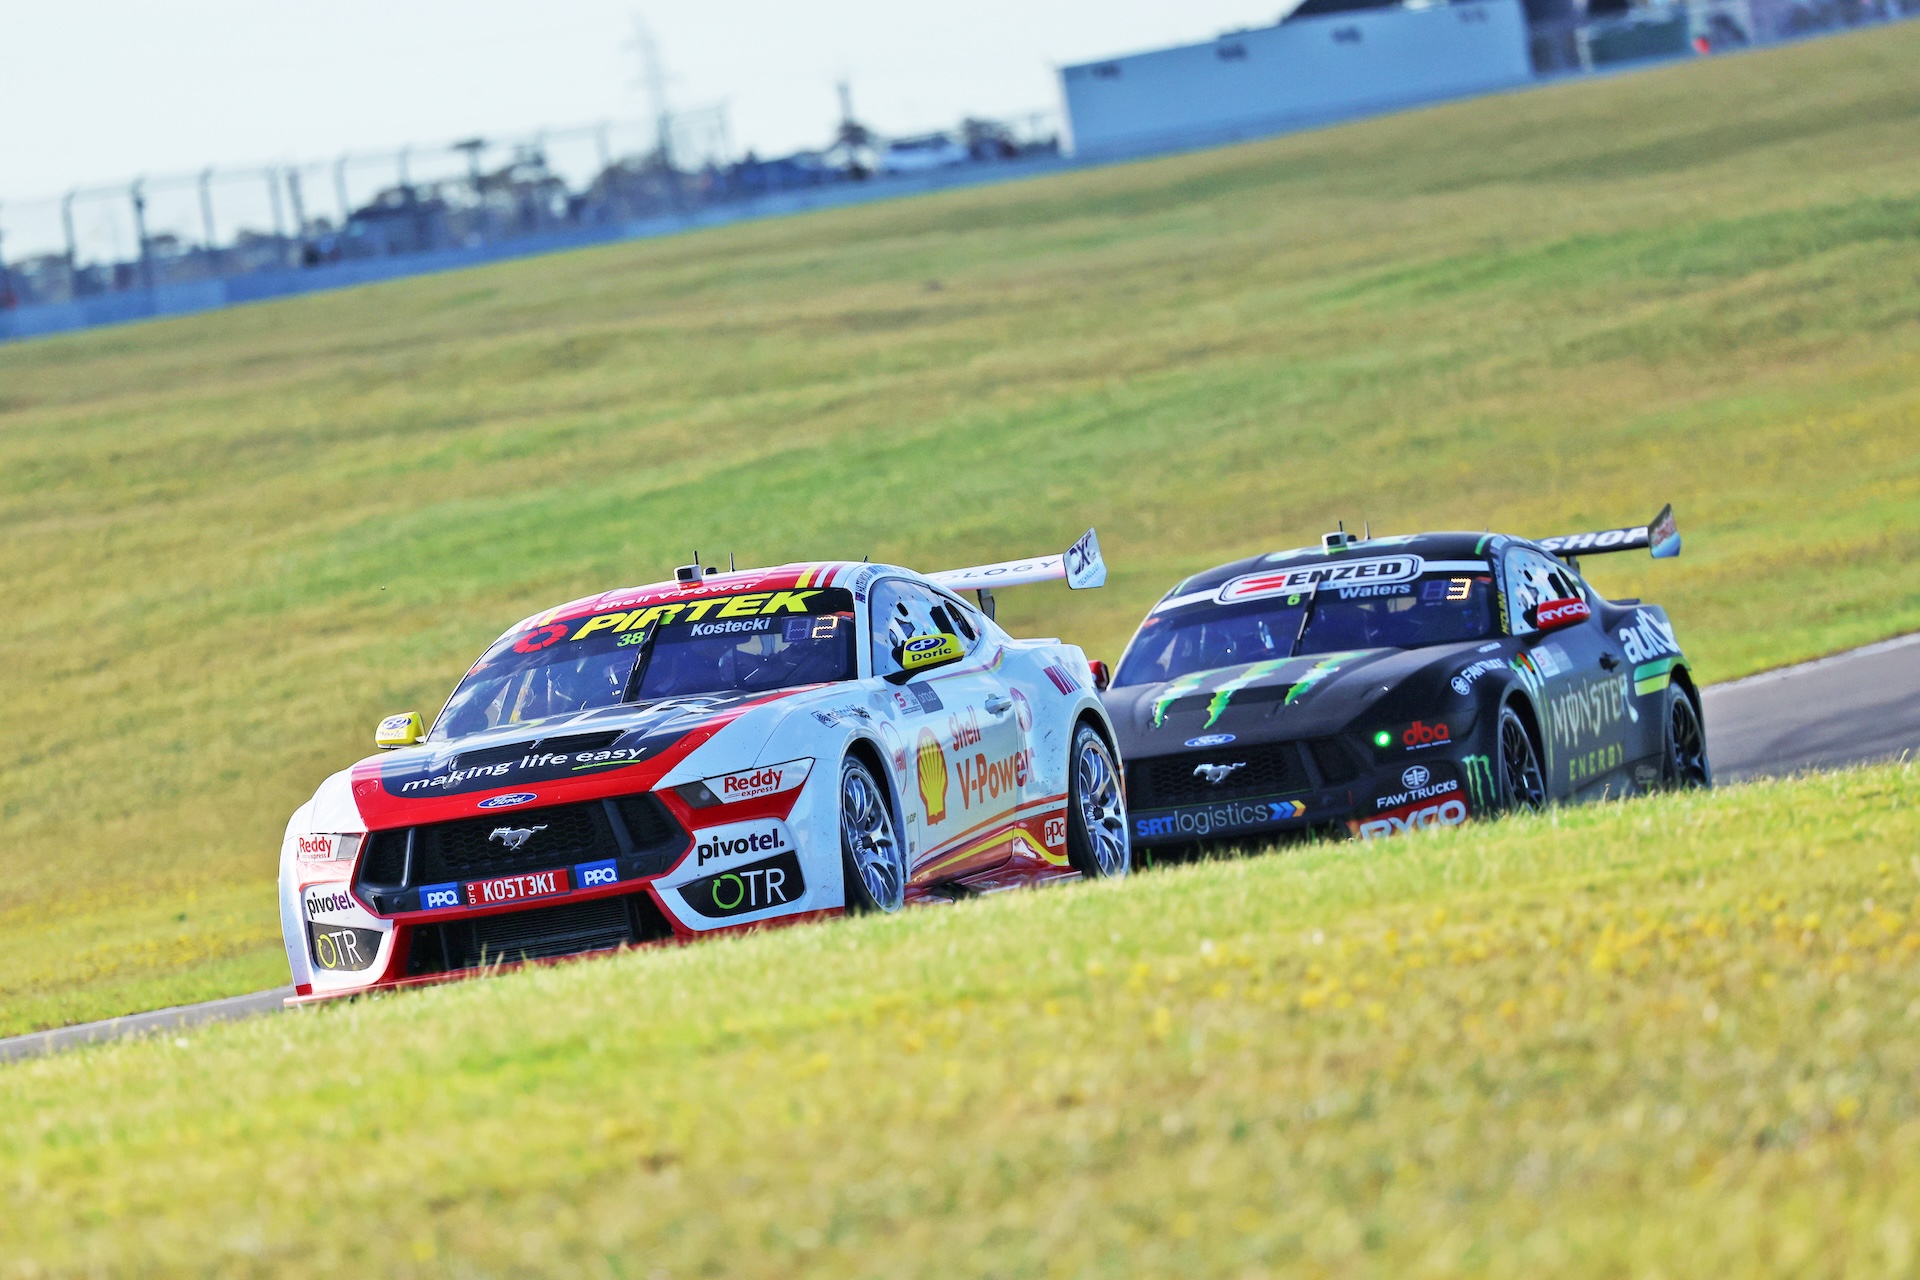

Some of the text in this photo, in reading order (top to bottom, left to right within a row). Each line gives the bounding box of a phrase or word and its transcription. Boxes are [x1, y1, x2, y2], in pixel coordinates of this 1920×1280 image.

[1286, 562, 1402, 586] ENZED
[594, 582, 757, 611] Shell V-Power
[1287, 593, 1301, 606] 6
[1338, 583, 1412, 600] Waters
[570, 590, 824, 641] PIRTEK
[1537, 602, 1590, 623] RYCO
[690, 617, 772, 637] Kostecki
[811, 615, 838, 639] 2
[616, 631, 645, 648] 38
[911, 647, 952, 662] Doric
[1552, 672, 1639, 748] MONSTER
[949, 704, 982, 752] Shell
[1403, 720, 1450, 746] dba
[401, 746, 647, 792] making life easy
[724, 769, 783, 793] Reddy
[956, 747, 1036, 810] V-Power
[488, 794, 526, 807] Ford
[741, 785, 773, 798] express
[1376, 780, 1458, 809] FAW TRUCKS
[298, 836, 332, 858] Reddy
[584, 866, 618, 886] PPQ
[427, 889, 459, 908] PPQ
[712, 867, 787, 910] OTR
[317, 929, 364, 969] OTR
